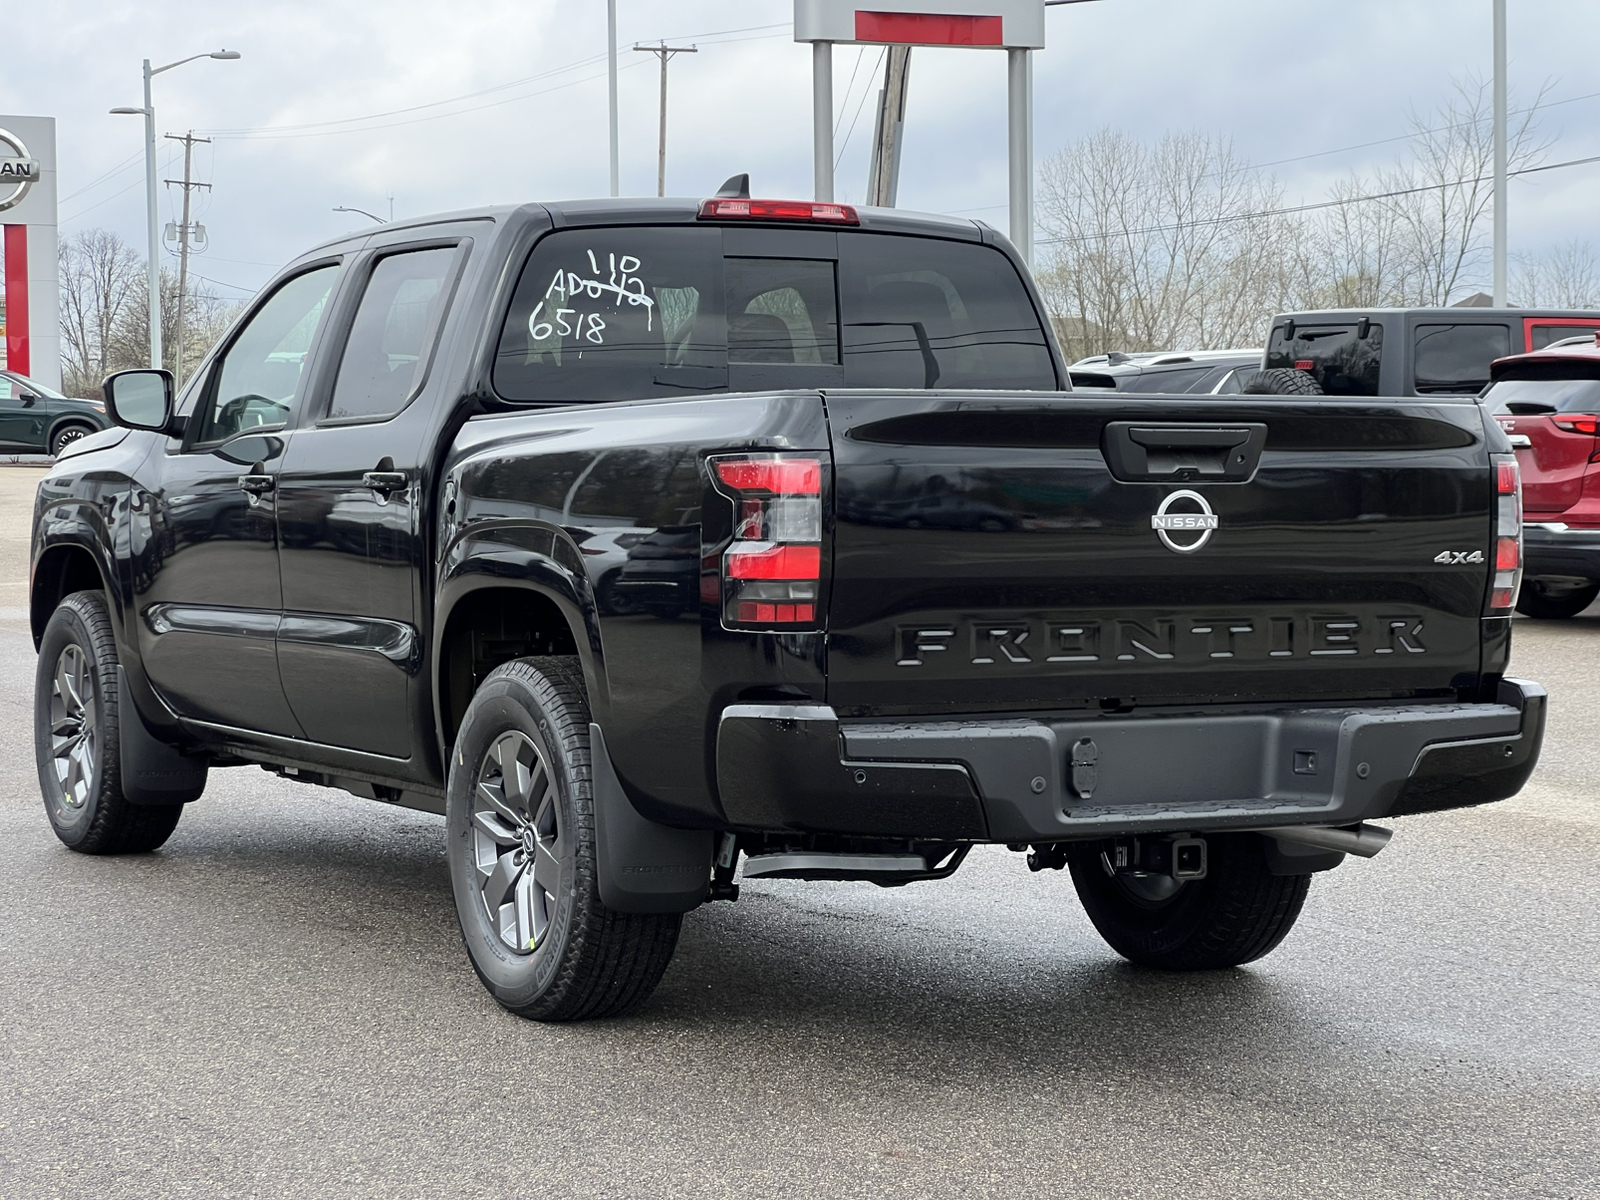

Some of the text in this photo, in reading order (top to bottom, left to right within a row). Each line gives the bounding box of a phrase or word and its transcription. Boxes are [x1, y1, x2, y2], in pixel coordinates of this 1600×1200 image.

[586, 249, 642, 275] 110
[528, 301, 607, 344] 6518
[1154, 517, 1217, 528] NISSAN
[1433, 550, 1485, 564] 4x4
[895, 613, 1427, 666] FRONTIER
[536, 902, 567, 984] MICHELIN
